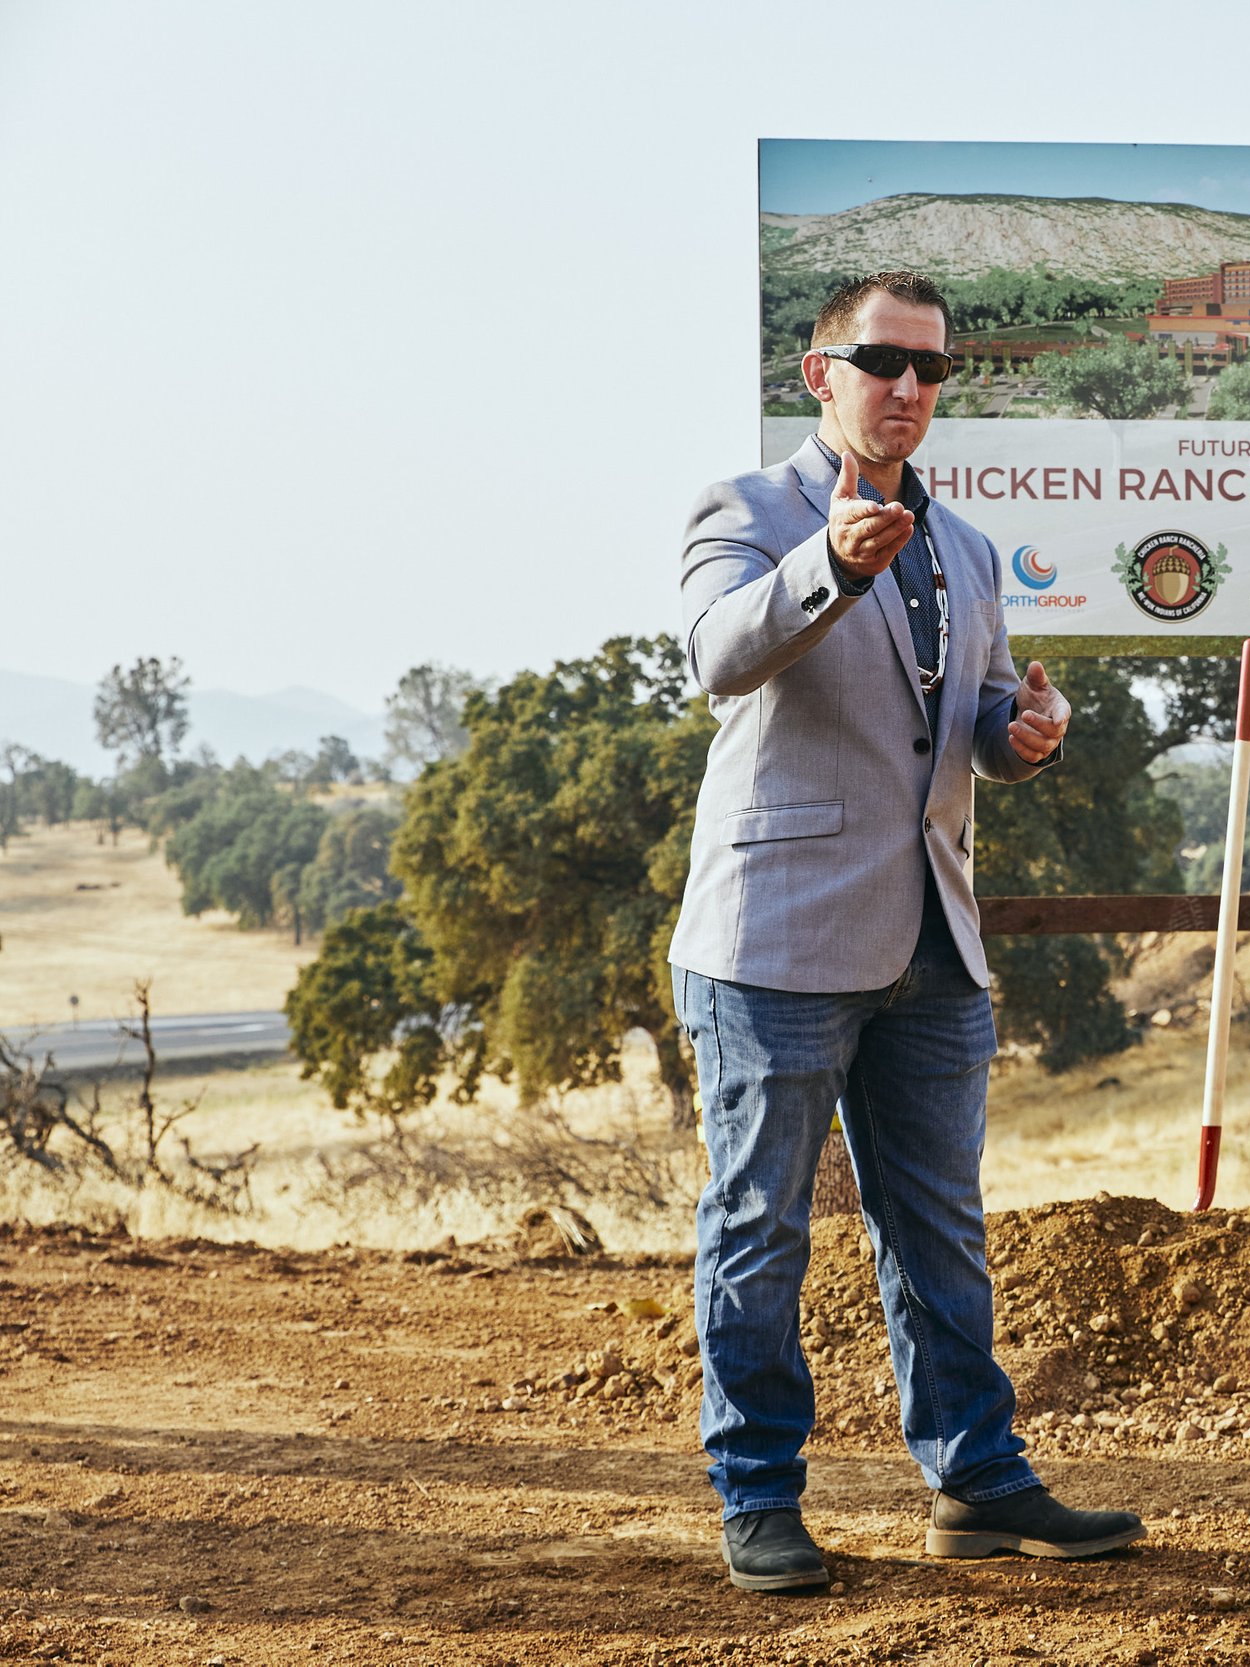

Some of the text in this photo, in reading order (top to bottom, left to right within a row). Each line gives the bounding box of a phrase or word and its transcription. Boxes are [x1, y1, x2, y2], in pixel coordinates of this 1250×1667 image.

[913, 466, 1101, 500] HICKEN
[1137, 538, 1159, 559] CHICKEN
[1158, 535, 1179, 544] RANCH
[1001, 595, 1086, 608] ORTHGROUP
